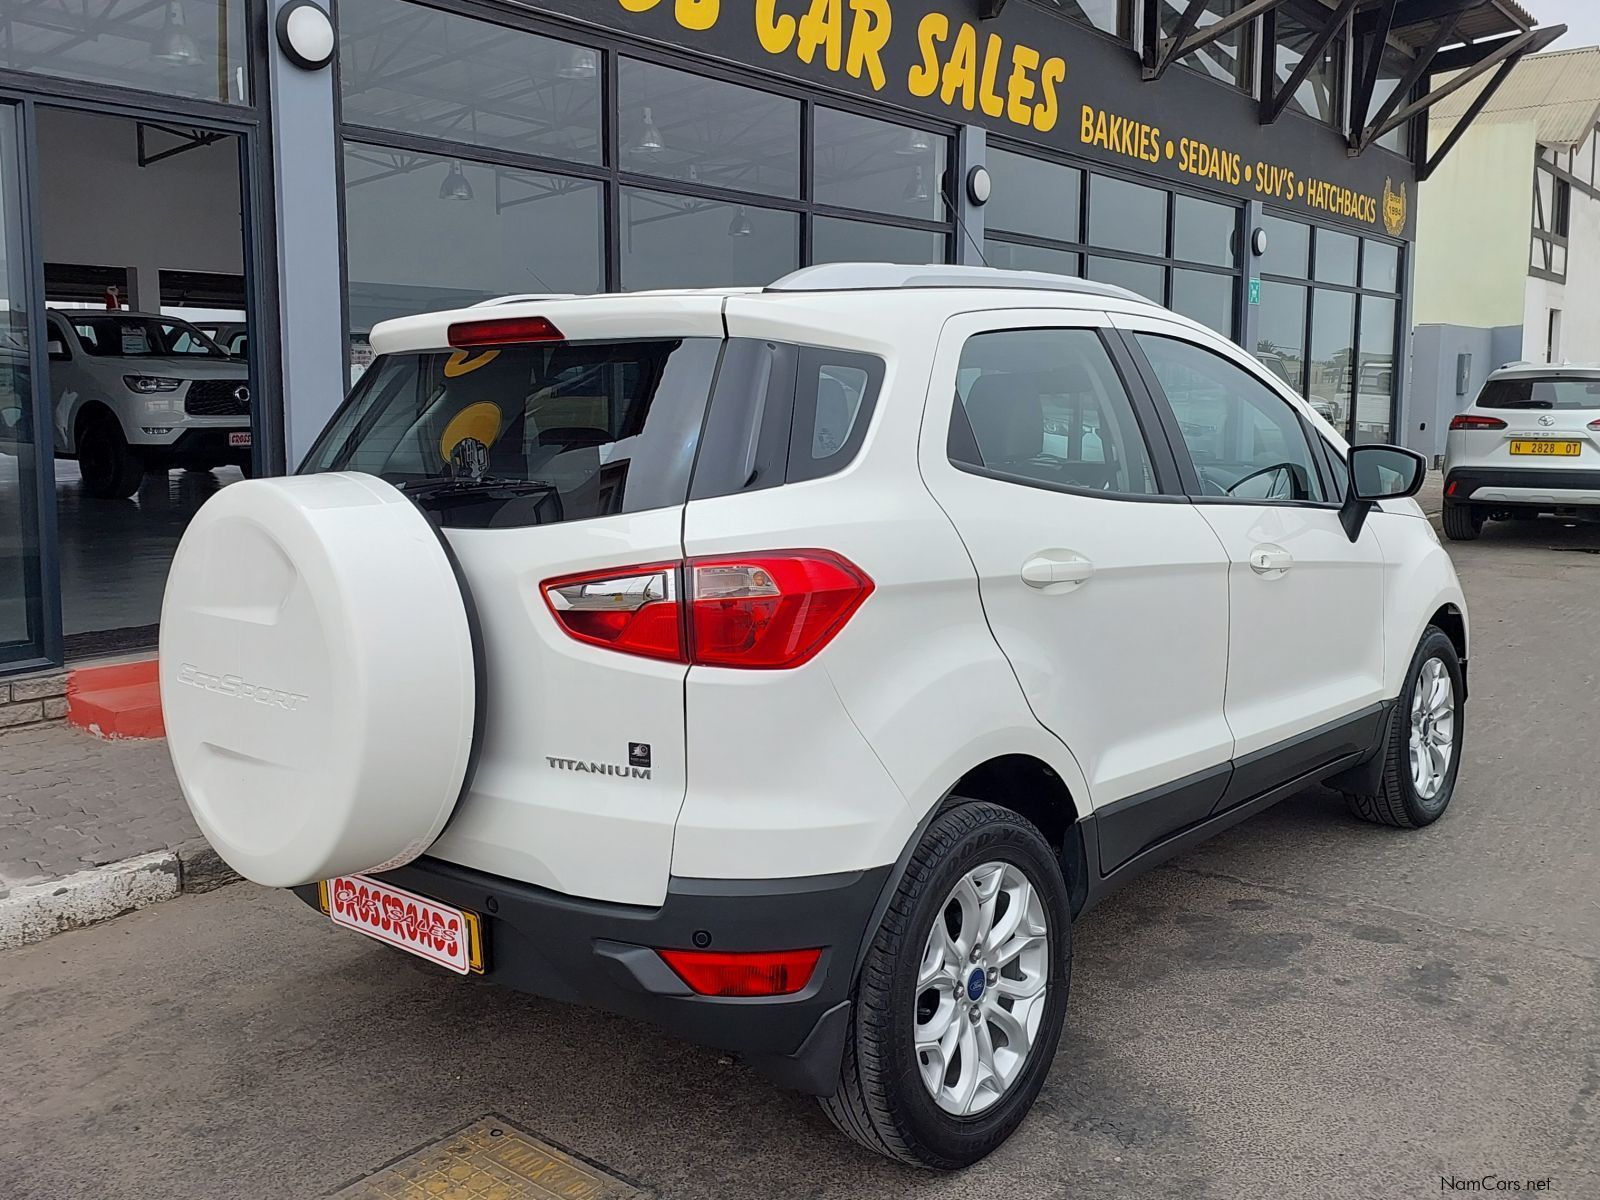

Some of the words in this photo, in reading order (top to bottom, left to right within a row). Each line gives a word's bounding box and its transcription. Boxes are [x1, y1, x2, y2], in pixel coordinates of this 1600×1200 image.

[907, 12, 1067, 133] SALES
[1079, 104, 1161, 164] BAKKIES
[1178, 137, 1241, 186] SEDANS
[1254, 160, 1295, 201] SUV'S
[1306, 177, 1377, 225] HATCHBACKS
[1514, 443, 1521, 453] N
[1531, 443, 1555, 454] 2828
[545, 756, 652, 780] TITANIUM
[334, 878, 459, 958] CROSSROADS
[336, 890, 377, 913] CAR
[387, 908, 457, 943] SALES
